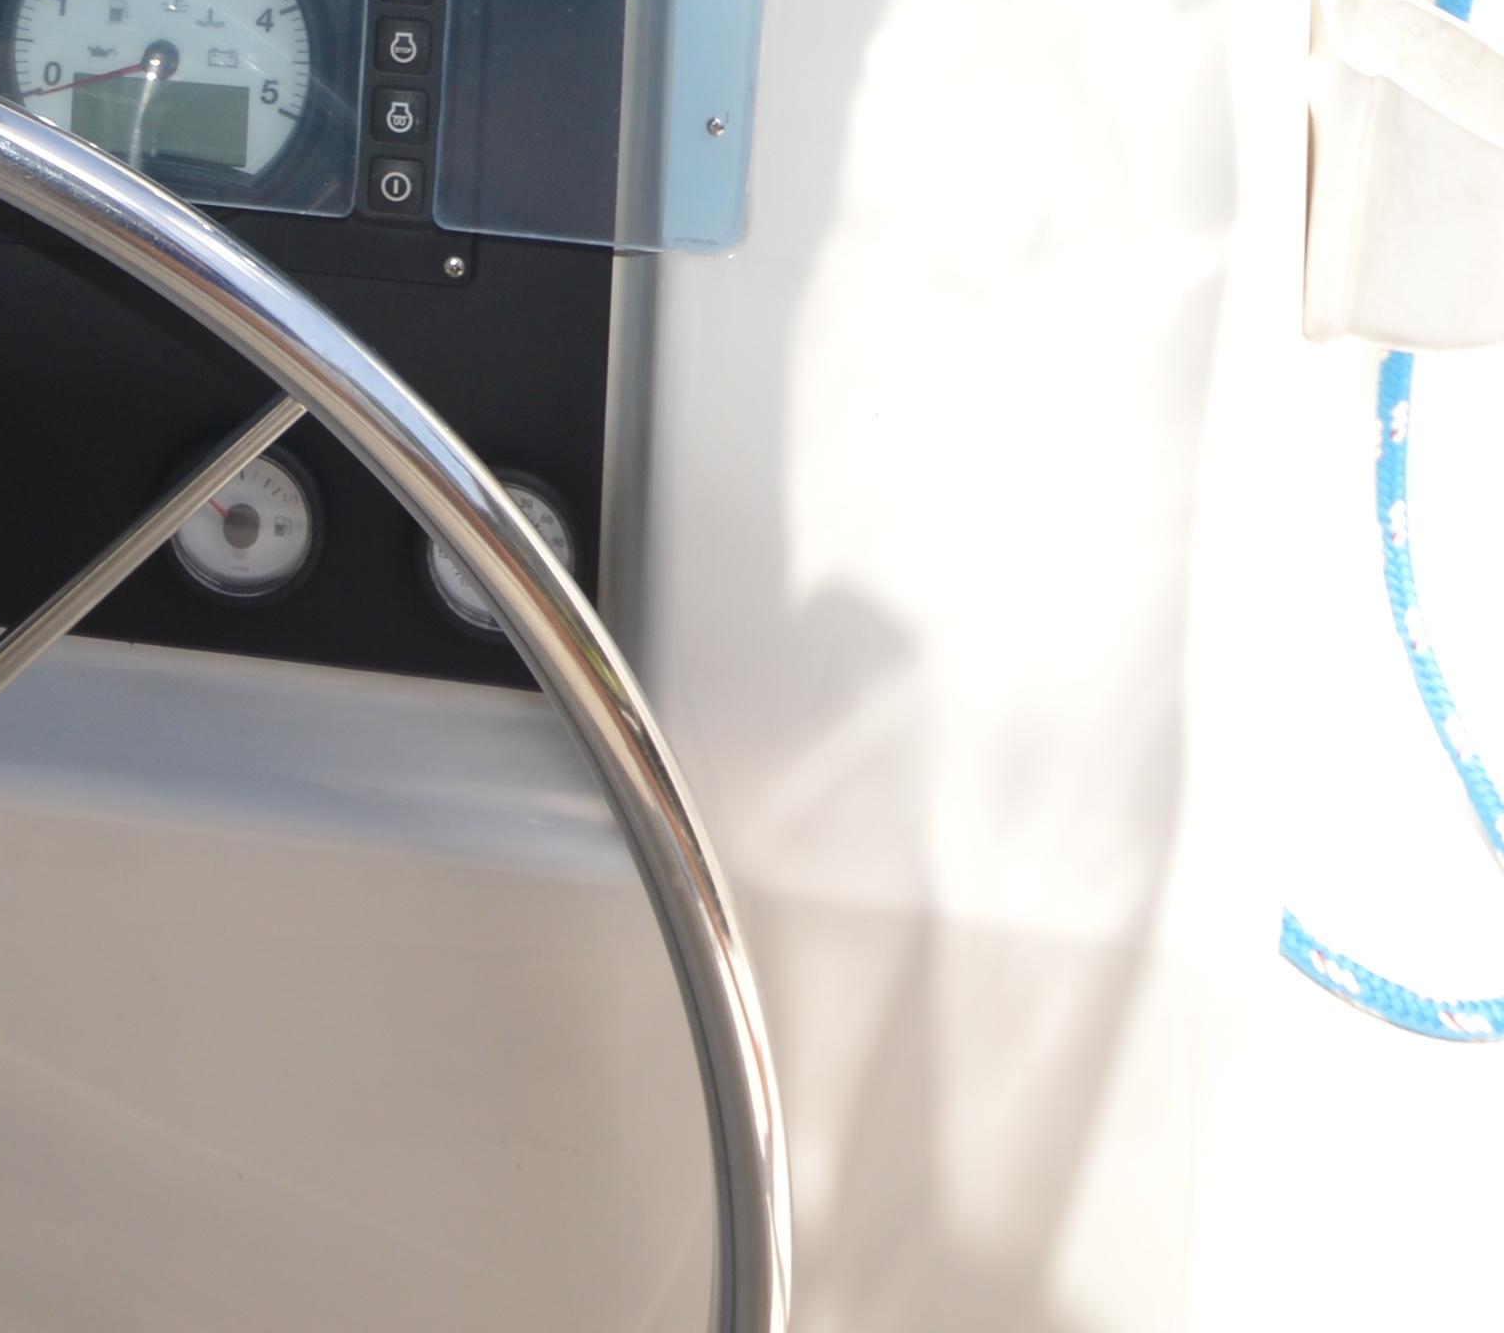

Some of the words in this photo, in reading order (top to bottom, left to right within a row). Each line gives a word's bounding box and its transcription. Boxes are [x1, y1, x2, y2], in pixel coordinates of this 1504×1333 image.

[256, 7, 275, 33] 4
[43, 61, 62, 86] 0
[260, 79, 280, 106] 5
